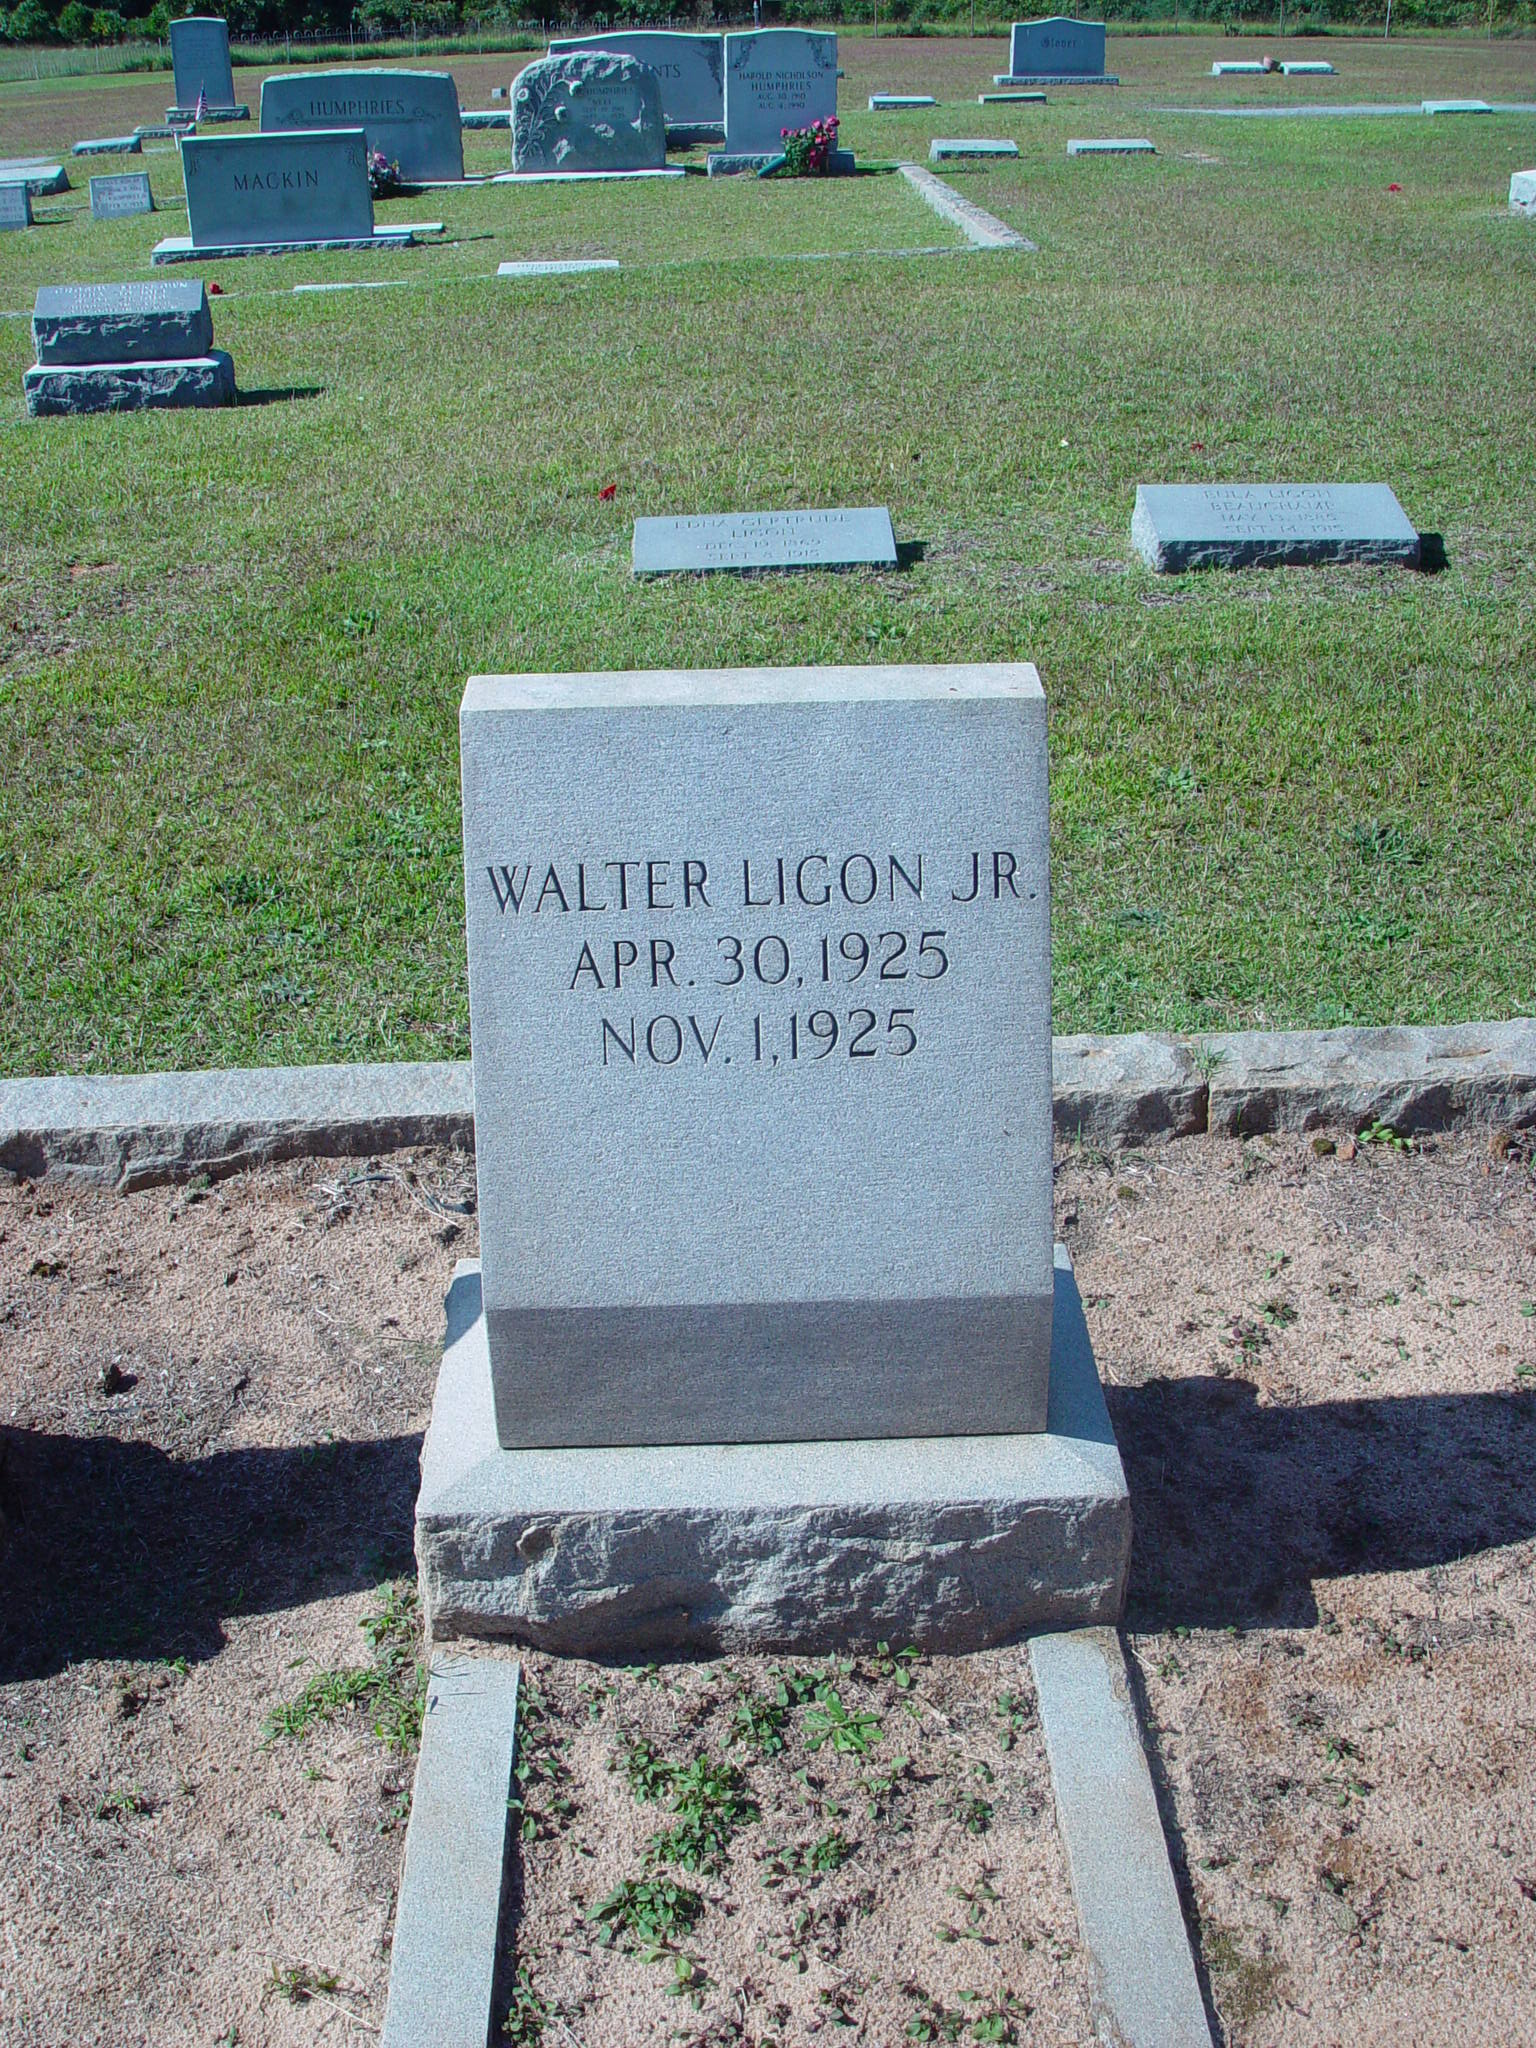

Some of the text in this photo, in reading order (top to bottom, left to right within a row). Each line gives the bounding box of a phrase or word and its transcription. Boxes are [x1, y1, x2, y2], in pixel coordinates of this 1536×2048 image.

[738, 71, 824, 81] HAROLD NICHOLSON
[751, 81, 812, 92] HUMPHRIES
[309, 99, 406, 116] HUMPHRIES
[232, 169, 320, 191] MACKIN
[1203, 488, 1333, 500] EULA LIGON
[1209, 501, 1336, 512] BEAUCHAMP
[674, 512, 852, 530] EDNA GERTRUDE
[730, 527, 798, 540] LIGON
[484, 850, 1044, 916] WALTER LIGON JR.
[568, 939, 699, 991] APR.
[601, 1013, 732, 1067] NOV.
